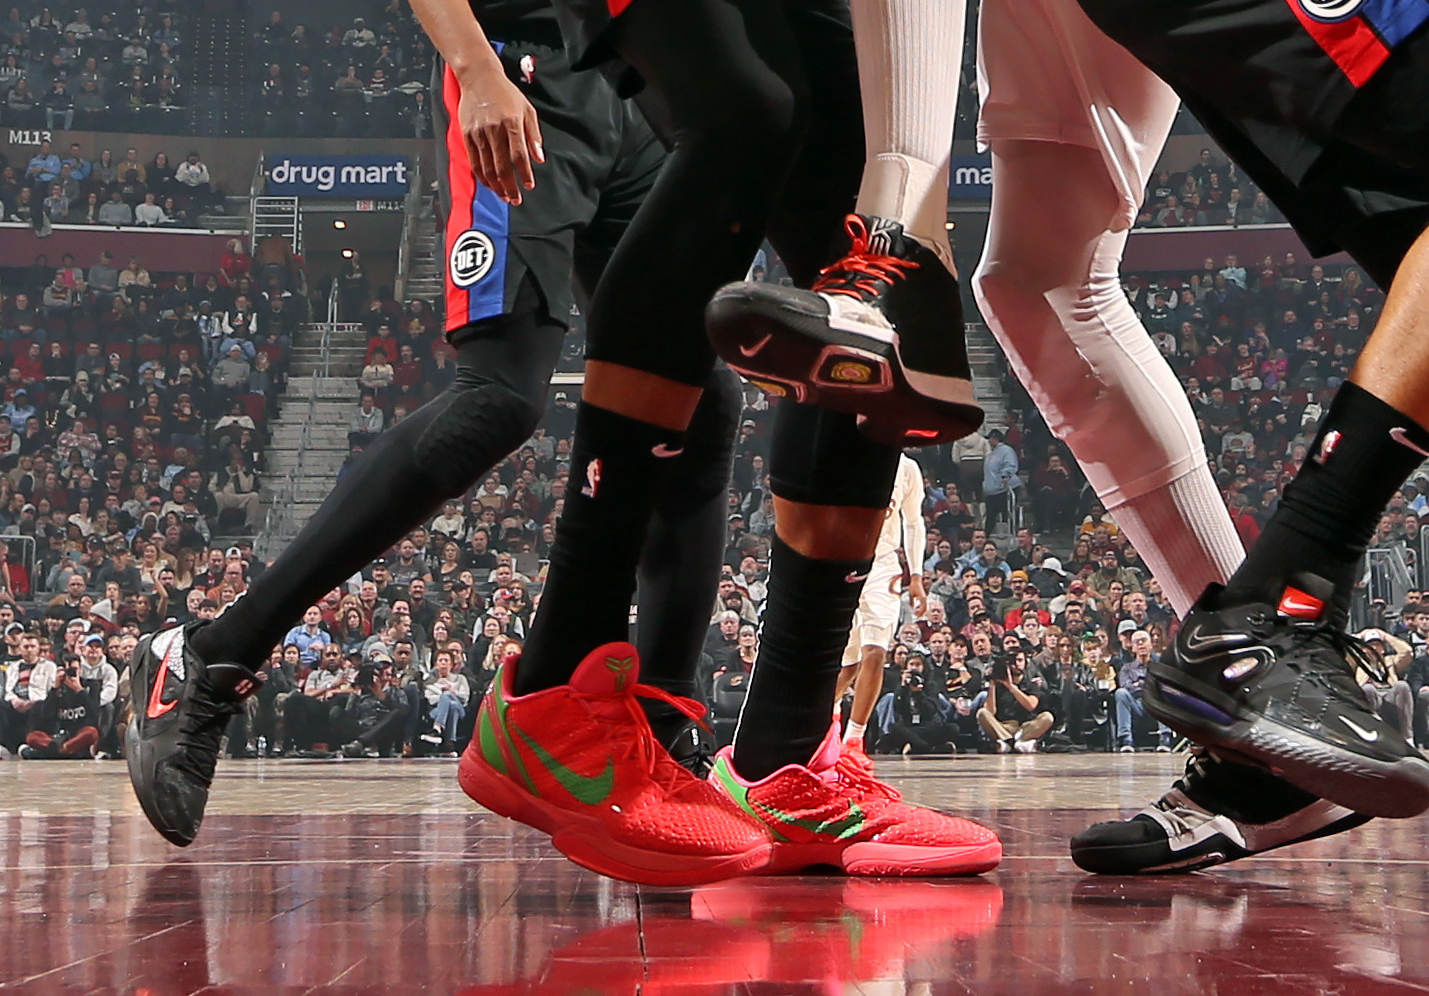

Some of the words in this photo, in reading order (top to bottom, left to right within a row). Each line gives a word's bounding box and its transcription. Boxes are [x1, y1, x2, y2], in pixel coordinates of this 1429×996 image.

[271, 160, 336, 192] drug
[340, 161, 408, 185] mart
[456, 246, 485, 271] DET
